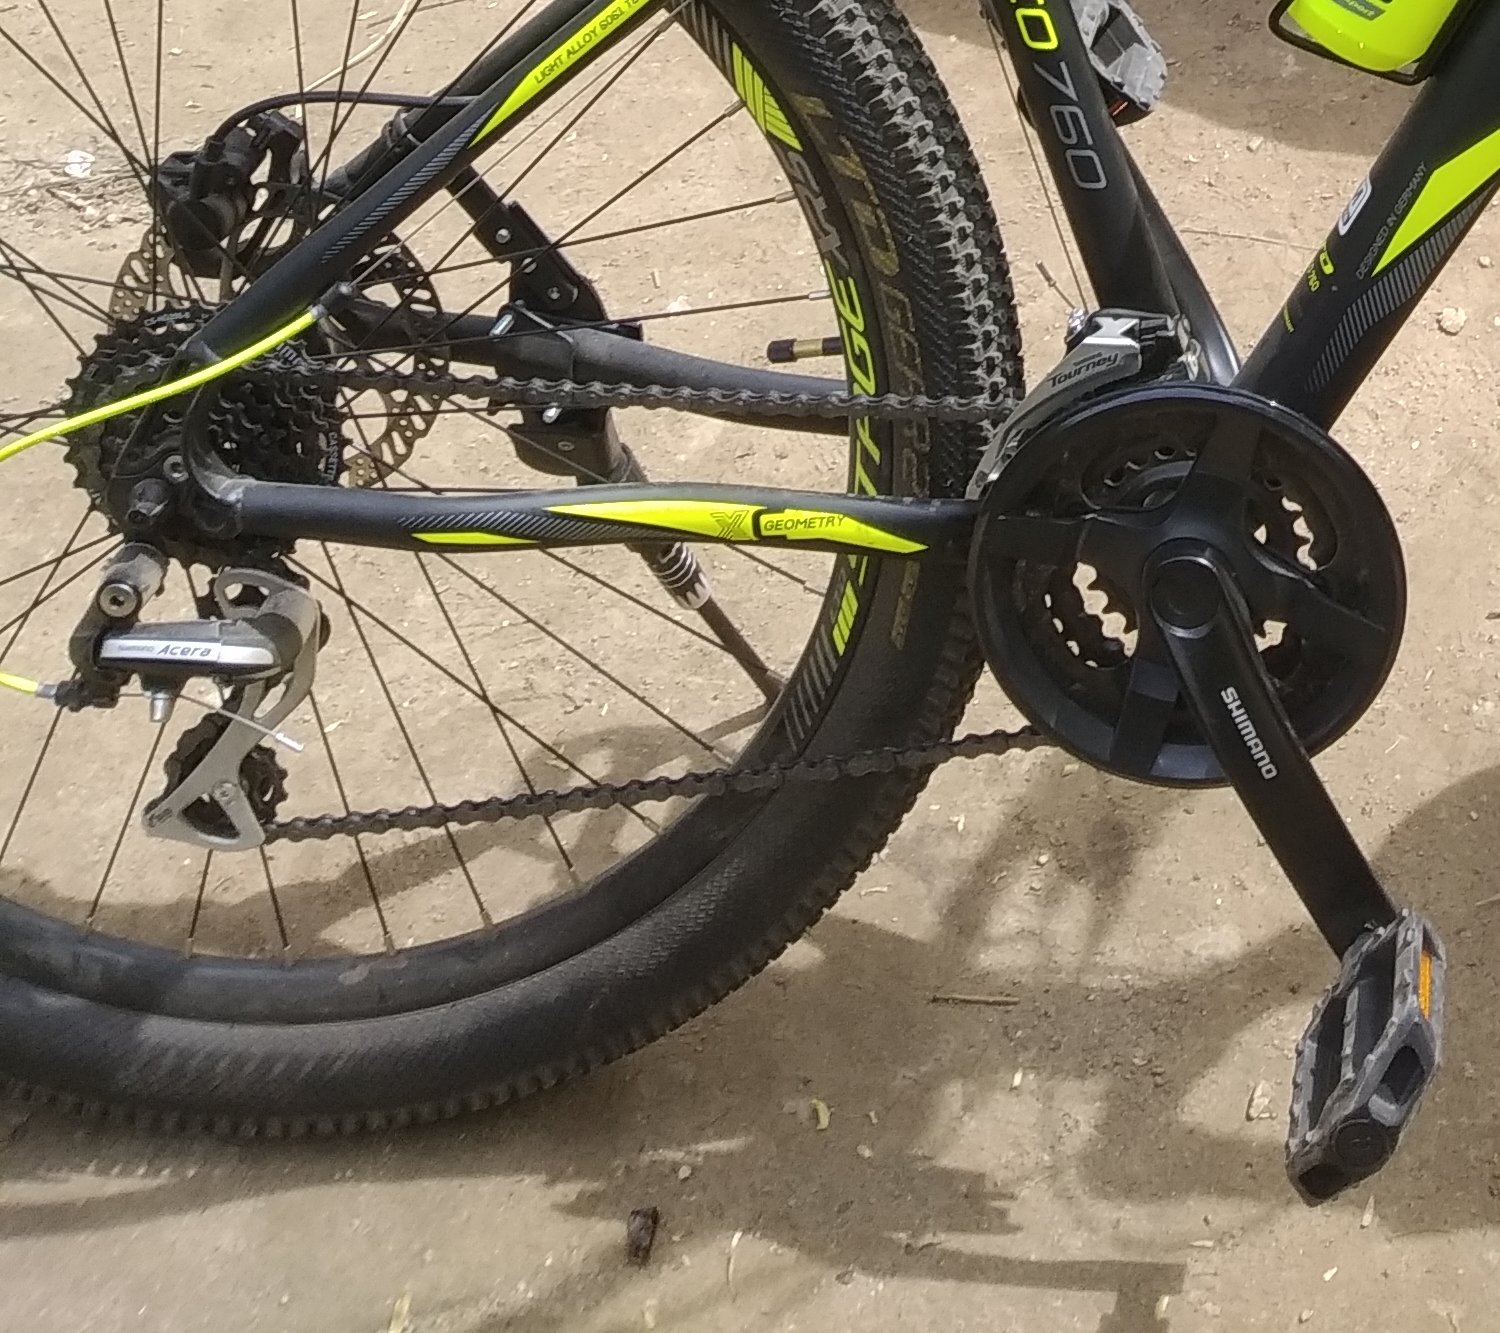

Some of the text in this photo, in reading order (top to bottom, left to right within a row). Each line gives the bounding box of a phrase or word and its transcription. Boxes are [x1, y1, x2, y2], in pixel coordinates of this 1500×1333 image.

[533, 55, 566, 85] LIGHT
[566, 26, 600, 59] ALLOY
[1032, 61, 1107, 190] 760
[1355, 162, 1428, 280] DESIGNED IN GERMANY
[1048, 352, 1119, 388] Tourney
[764, 515, 845, 532] GEOMETRY
[157, 644, 212, 657] Acera
[1220, 686, 1278, 780] SHIMANO
